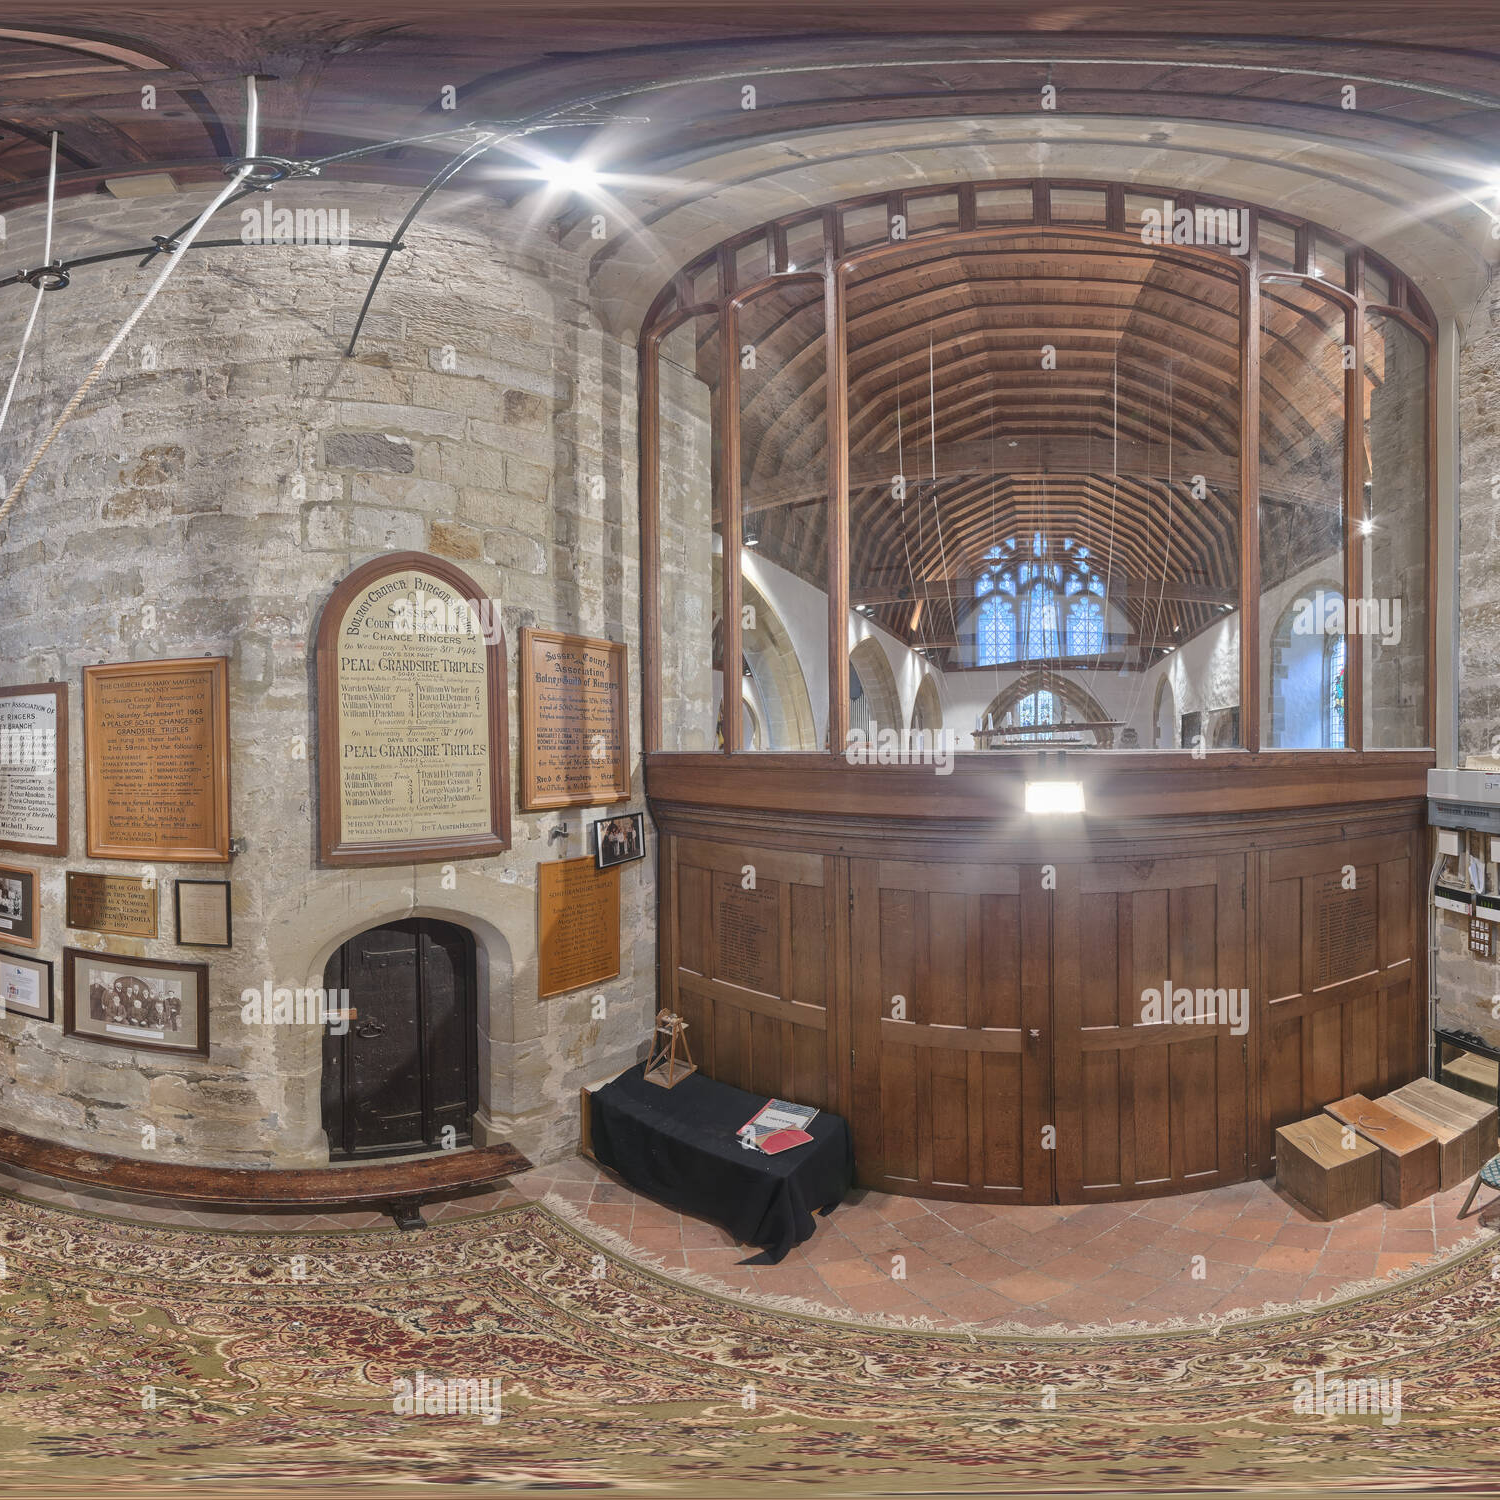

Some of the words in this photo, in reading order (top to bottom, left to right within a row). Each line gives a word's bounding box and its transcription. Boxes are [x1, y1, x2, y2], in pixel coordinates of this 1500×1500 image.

[373, 632, 412, 642] CHANGE
[418, 634, 461, 644] RINGERS
[341, 658, 374, 671] PEAL
[378, 658, 440, 672] GRANDSIRE
[441, 660, 484, 674] TRIPLES
[12, 702, 45, 711] ASSOCIATION
[344, 744, 376, 758] PEAL
[380, 744, 439, 758] GRANDSIRE
[441, 744, 486, 757] TRIPLES
